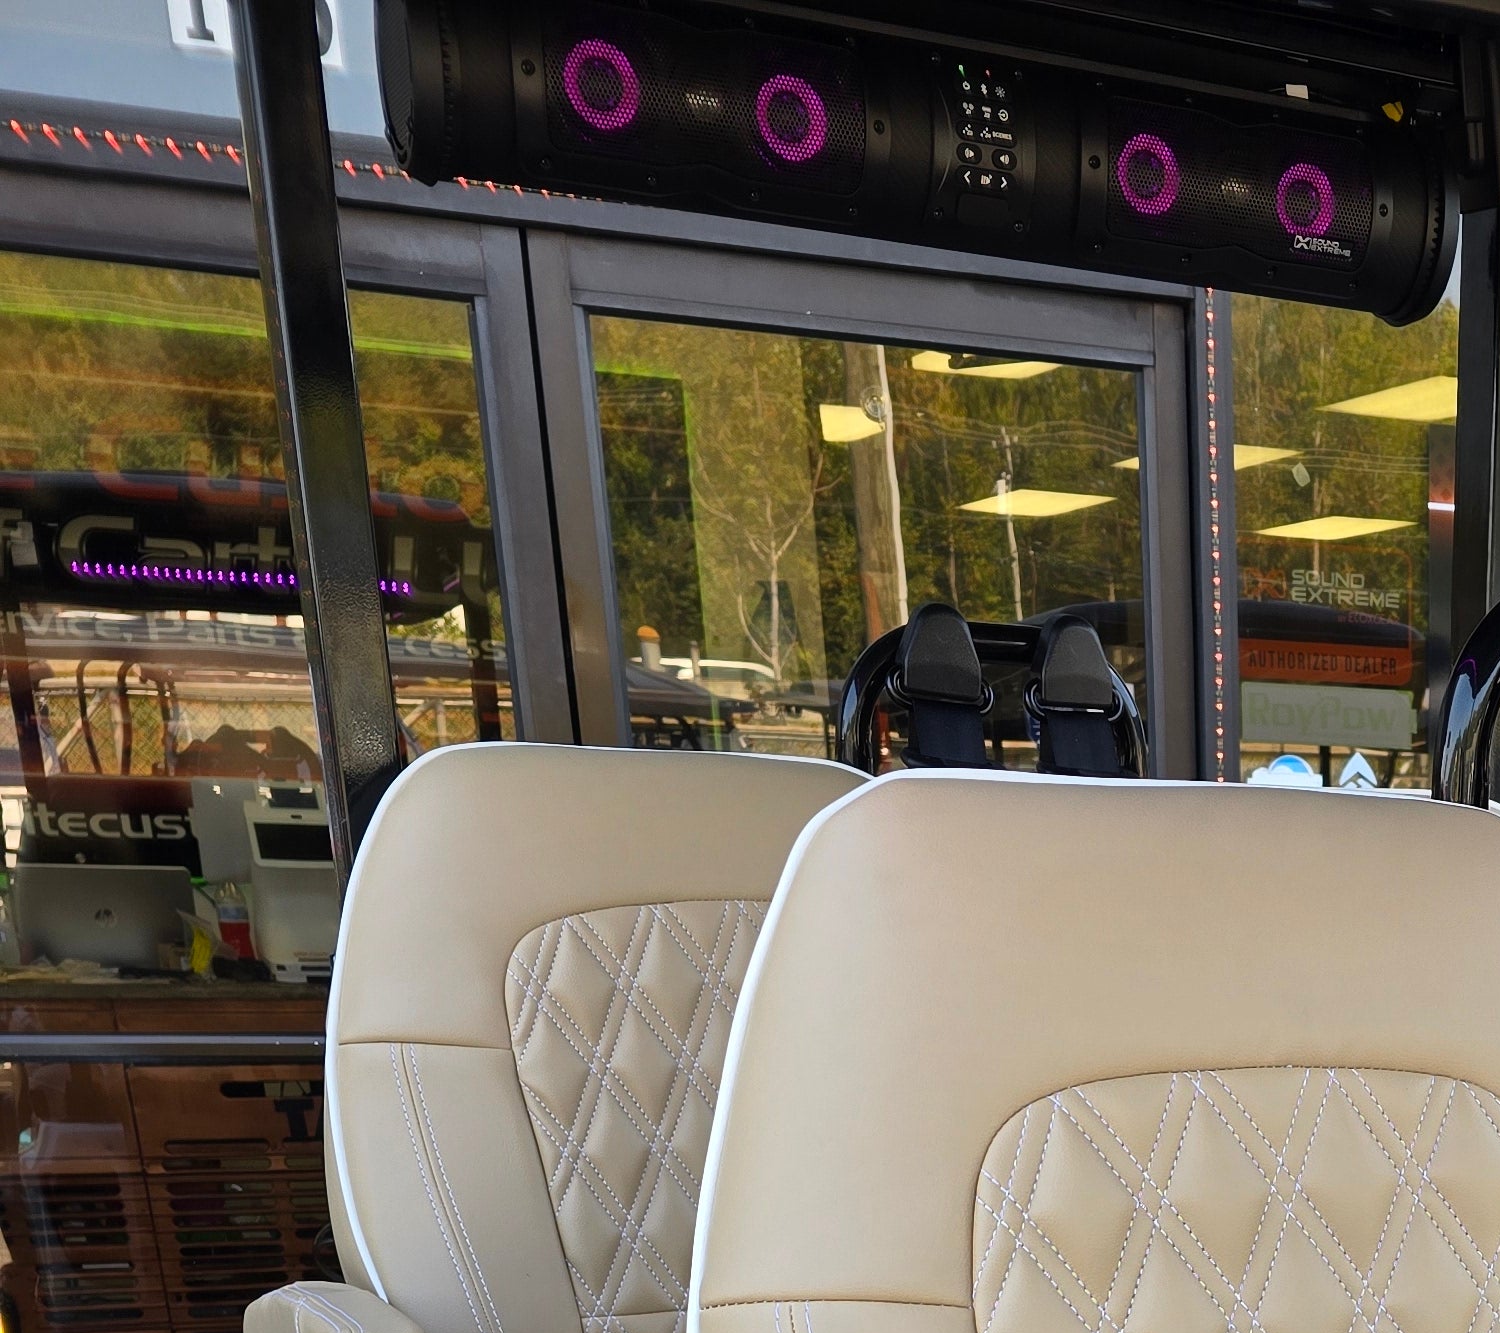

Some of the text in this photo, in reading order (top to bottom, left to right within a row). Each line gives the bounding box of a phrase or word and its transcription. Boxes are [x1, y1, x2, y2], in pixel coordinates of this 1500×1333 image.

[1311, 244, 1351, 257] EXTREME
[1312, 238, 1340, 249] SOUND
[1291, 569, 1365, 589] SOUND
[1291, 586, 1400, 609] EXTREME
[1247, 650, 1398, 676] AUTHORIZED DEALER
